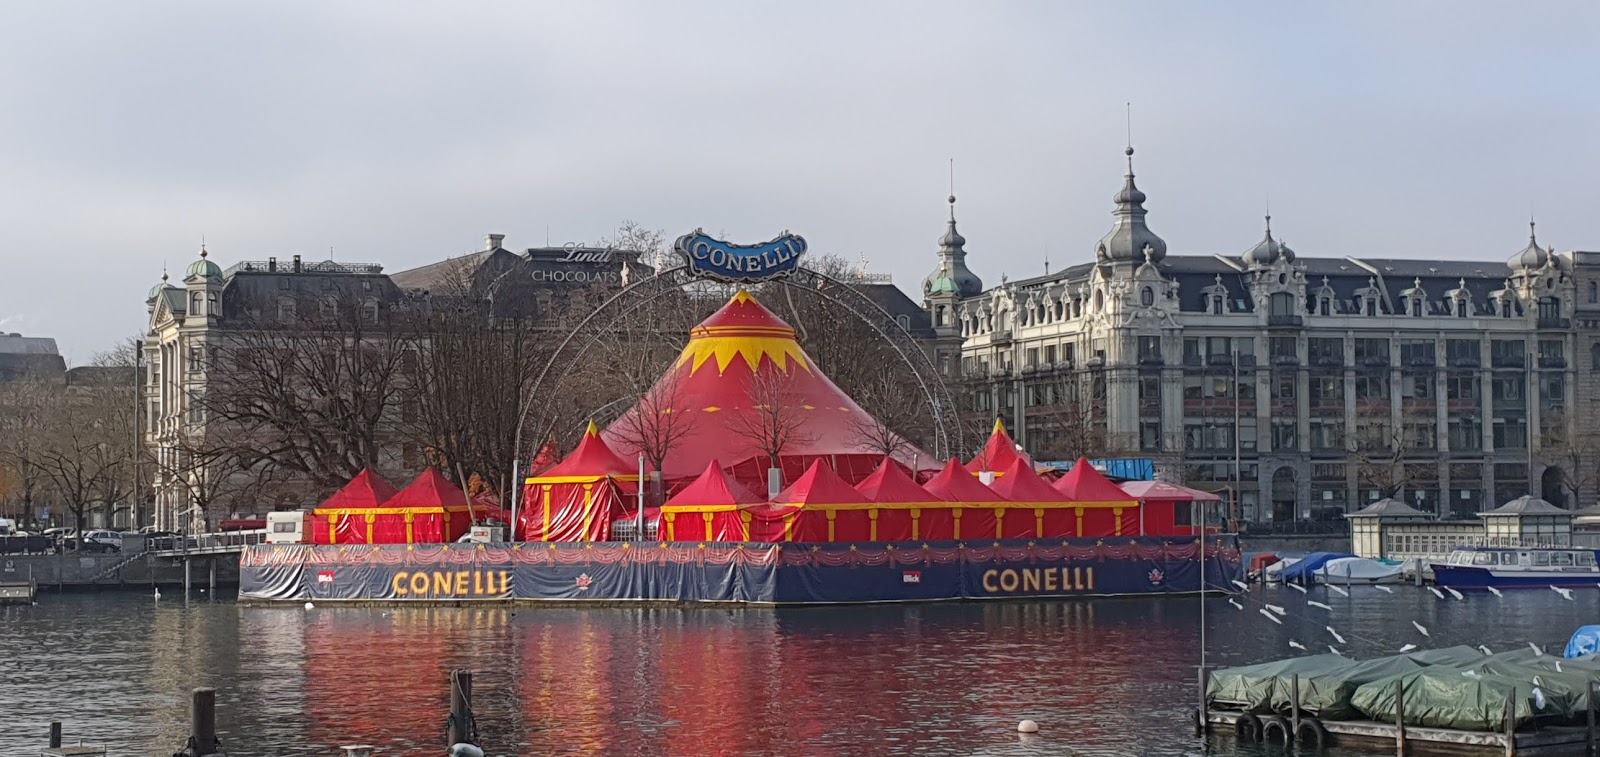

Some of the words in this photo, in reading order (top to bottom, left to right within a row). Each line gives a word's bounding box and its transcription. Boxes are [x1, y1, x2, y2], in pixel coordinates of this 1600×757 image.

[556, 242, 616, 263] Lindt
[692, 241, 799, 272] CONELLI
[531, 270, 617, 282] CHOCOLATS
[391, 570, 509, 595] CONELLI
[903, 574, 920, 583] Blick
[982, 566, 1094, 593] CONELLI
